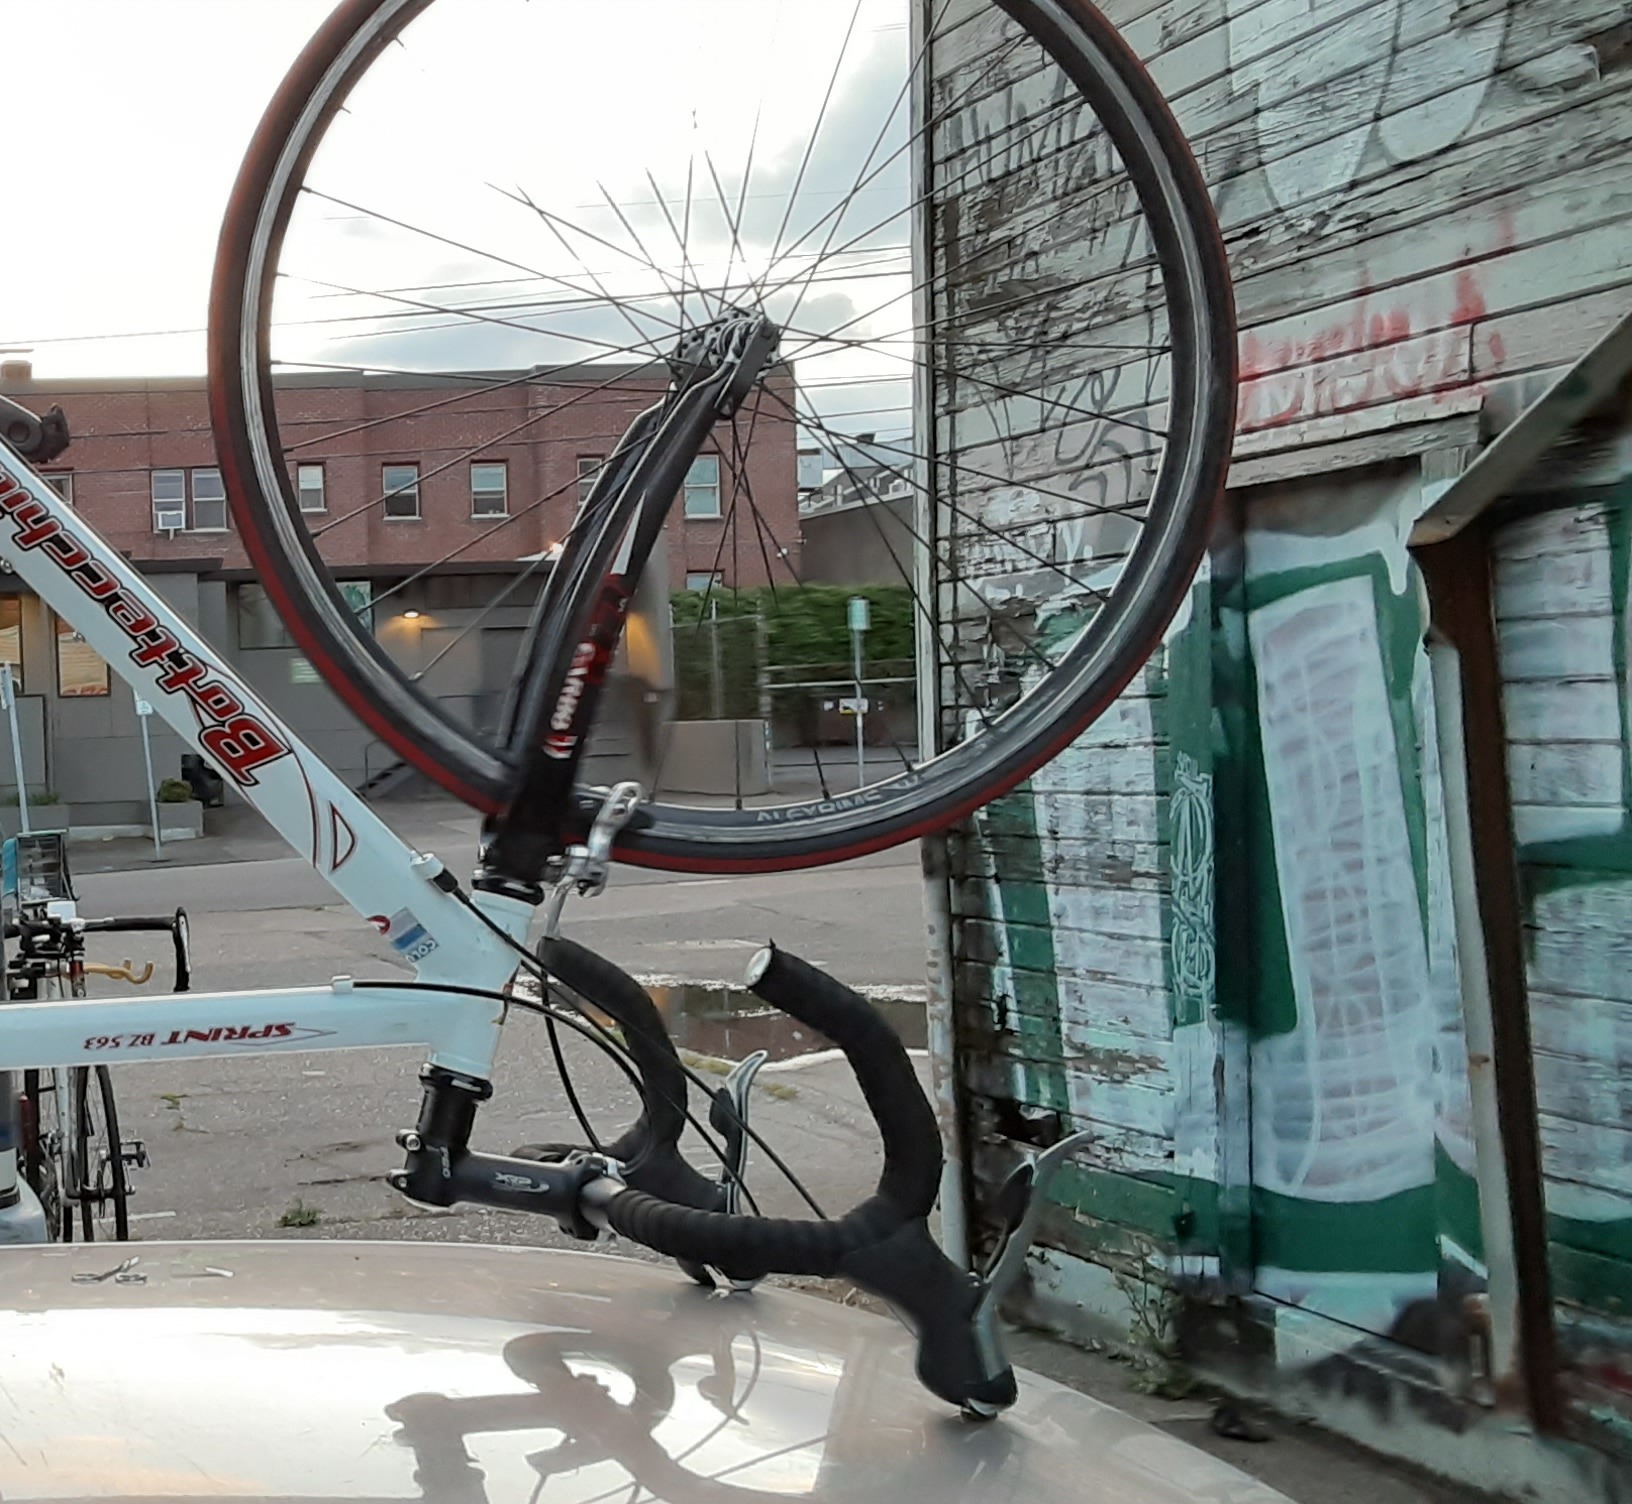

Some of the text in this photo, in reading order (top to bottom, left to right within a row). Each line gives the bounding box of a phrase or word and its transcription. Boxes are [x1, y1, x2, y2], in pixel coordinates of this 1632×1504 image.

[84, 1022, 296, 1050] SPRINT BZ 563
